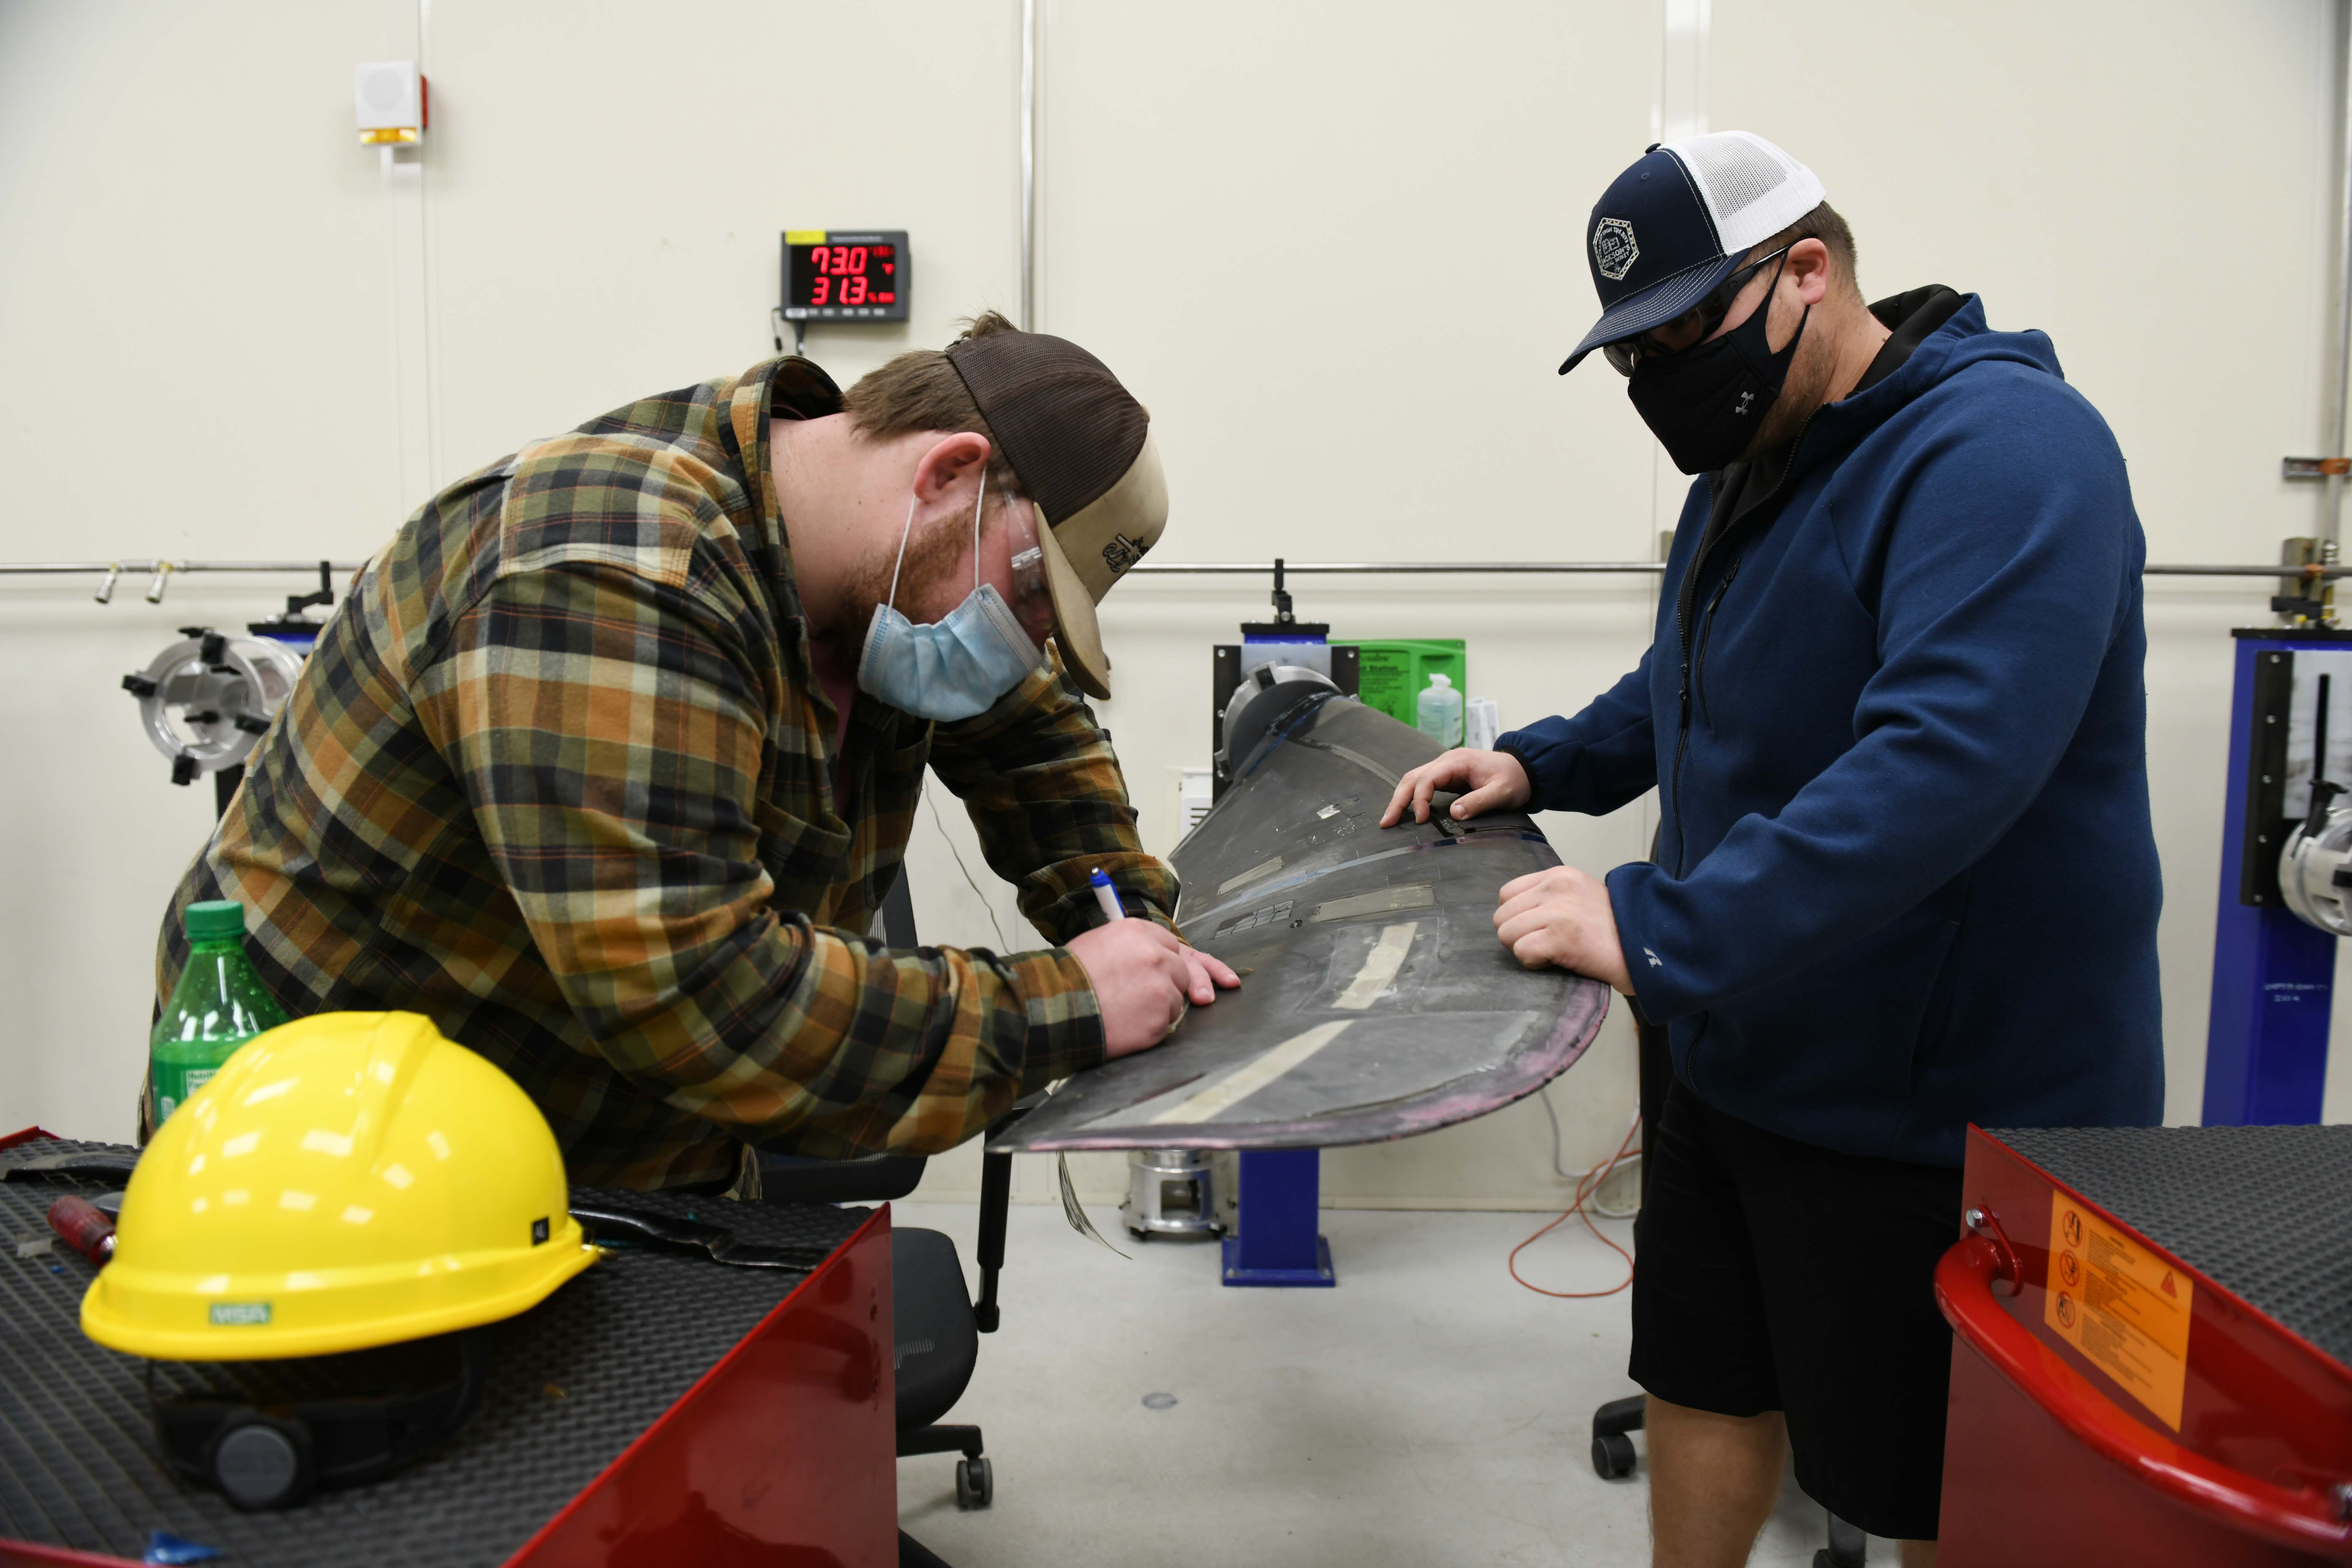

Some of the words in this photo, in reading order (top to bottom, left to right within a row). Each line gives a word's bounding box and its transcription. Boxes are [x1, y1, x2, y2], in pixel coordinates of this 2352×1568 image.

[1601, 244, 1630, 267] JACKSON'S
[1615, 251, 1630, 262] HONEY
[213, 1306, 267, 1324] MSA
